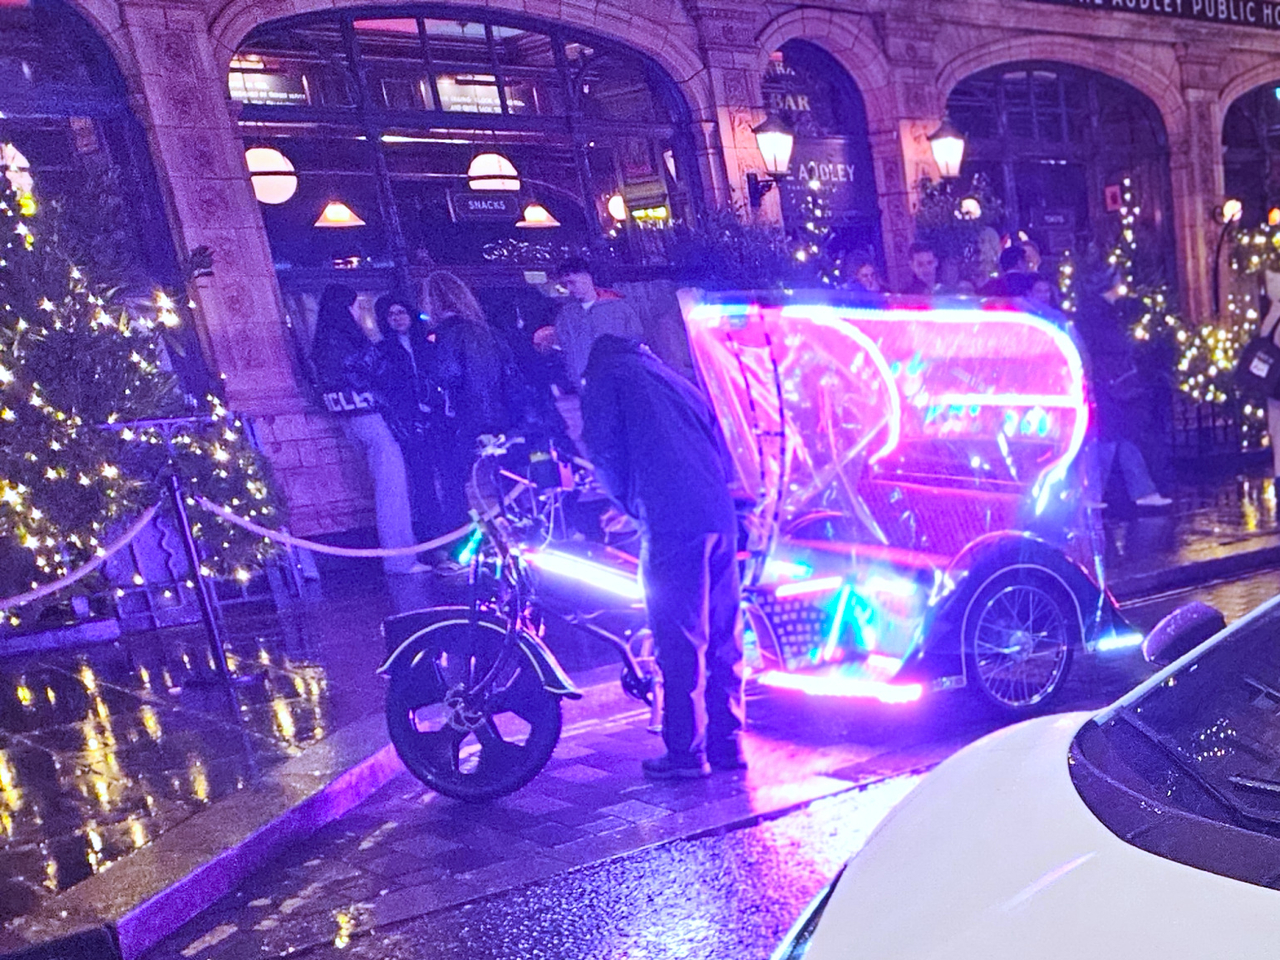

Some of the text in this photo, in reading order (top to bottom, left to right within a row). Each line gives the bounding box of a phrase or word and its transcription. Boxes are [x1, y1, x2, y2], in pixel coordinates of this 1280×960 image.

[1192, 0, 1256, 22] PUBLIC
[771, 94, 811, 111] BAR
[468, 200, 506, 210] SNACKS
